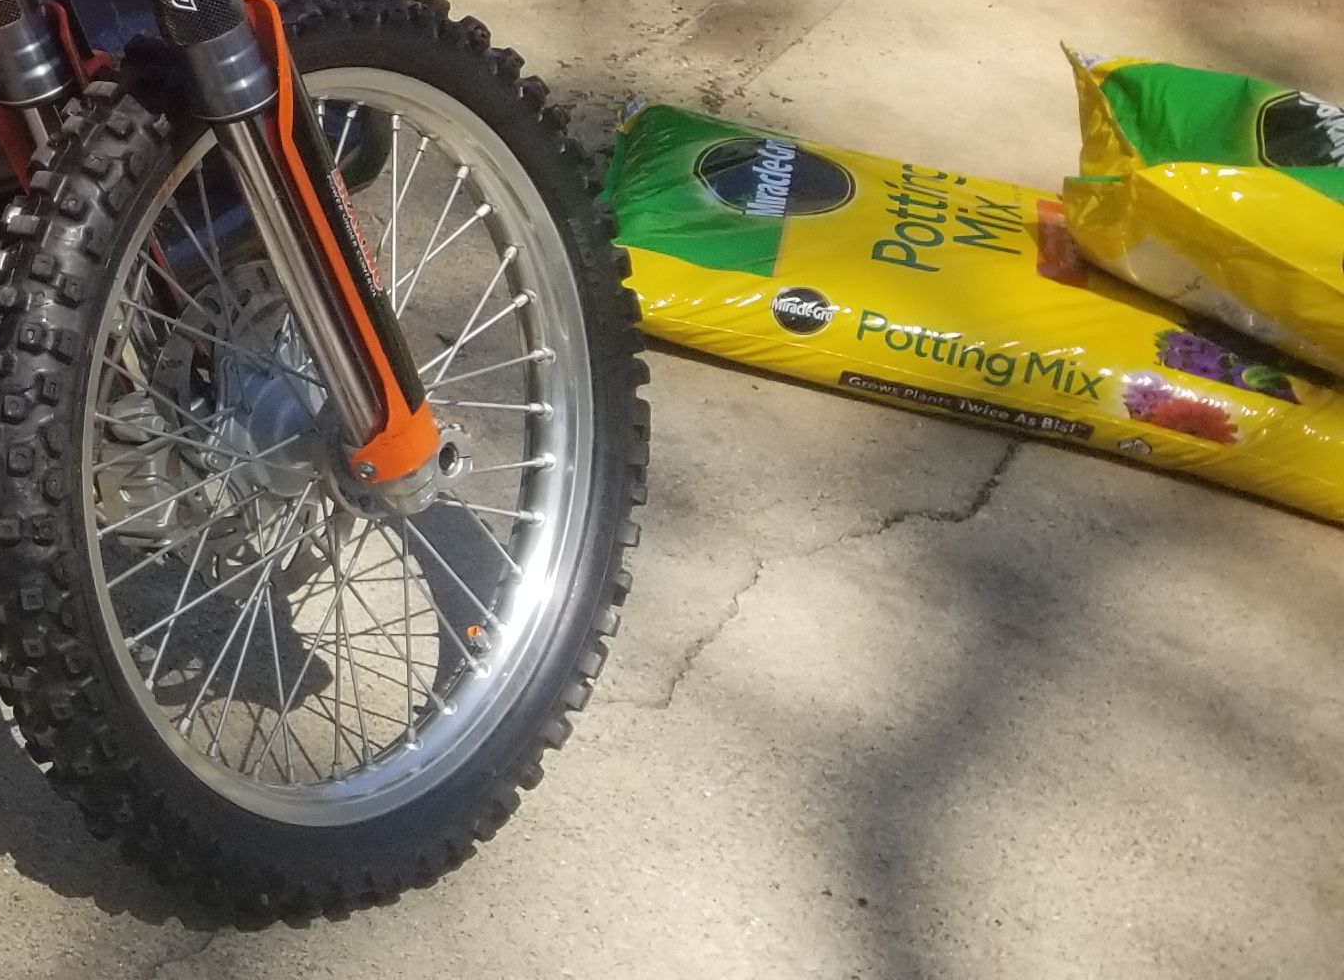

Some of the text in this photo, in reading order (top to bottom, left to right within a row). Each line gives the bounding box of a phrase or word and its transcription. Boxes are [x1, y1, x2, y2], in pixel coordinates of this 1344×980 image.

[953, 195, 1023, 255] Mix
[771, 297, 834, 323] Miracle-Gro
[856, 309, 1109, 401] Potting Mix
[848, 376, 899, 396] Grows
[903, 387, 953, 407] Plants
[957, 399, 1011, 420] Twice
[1015, 411, 1037, 427] As
